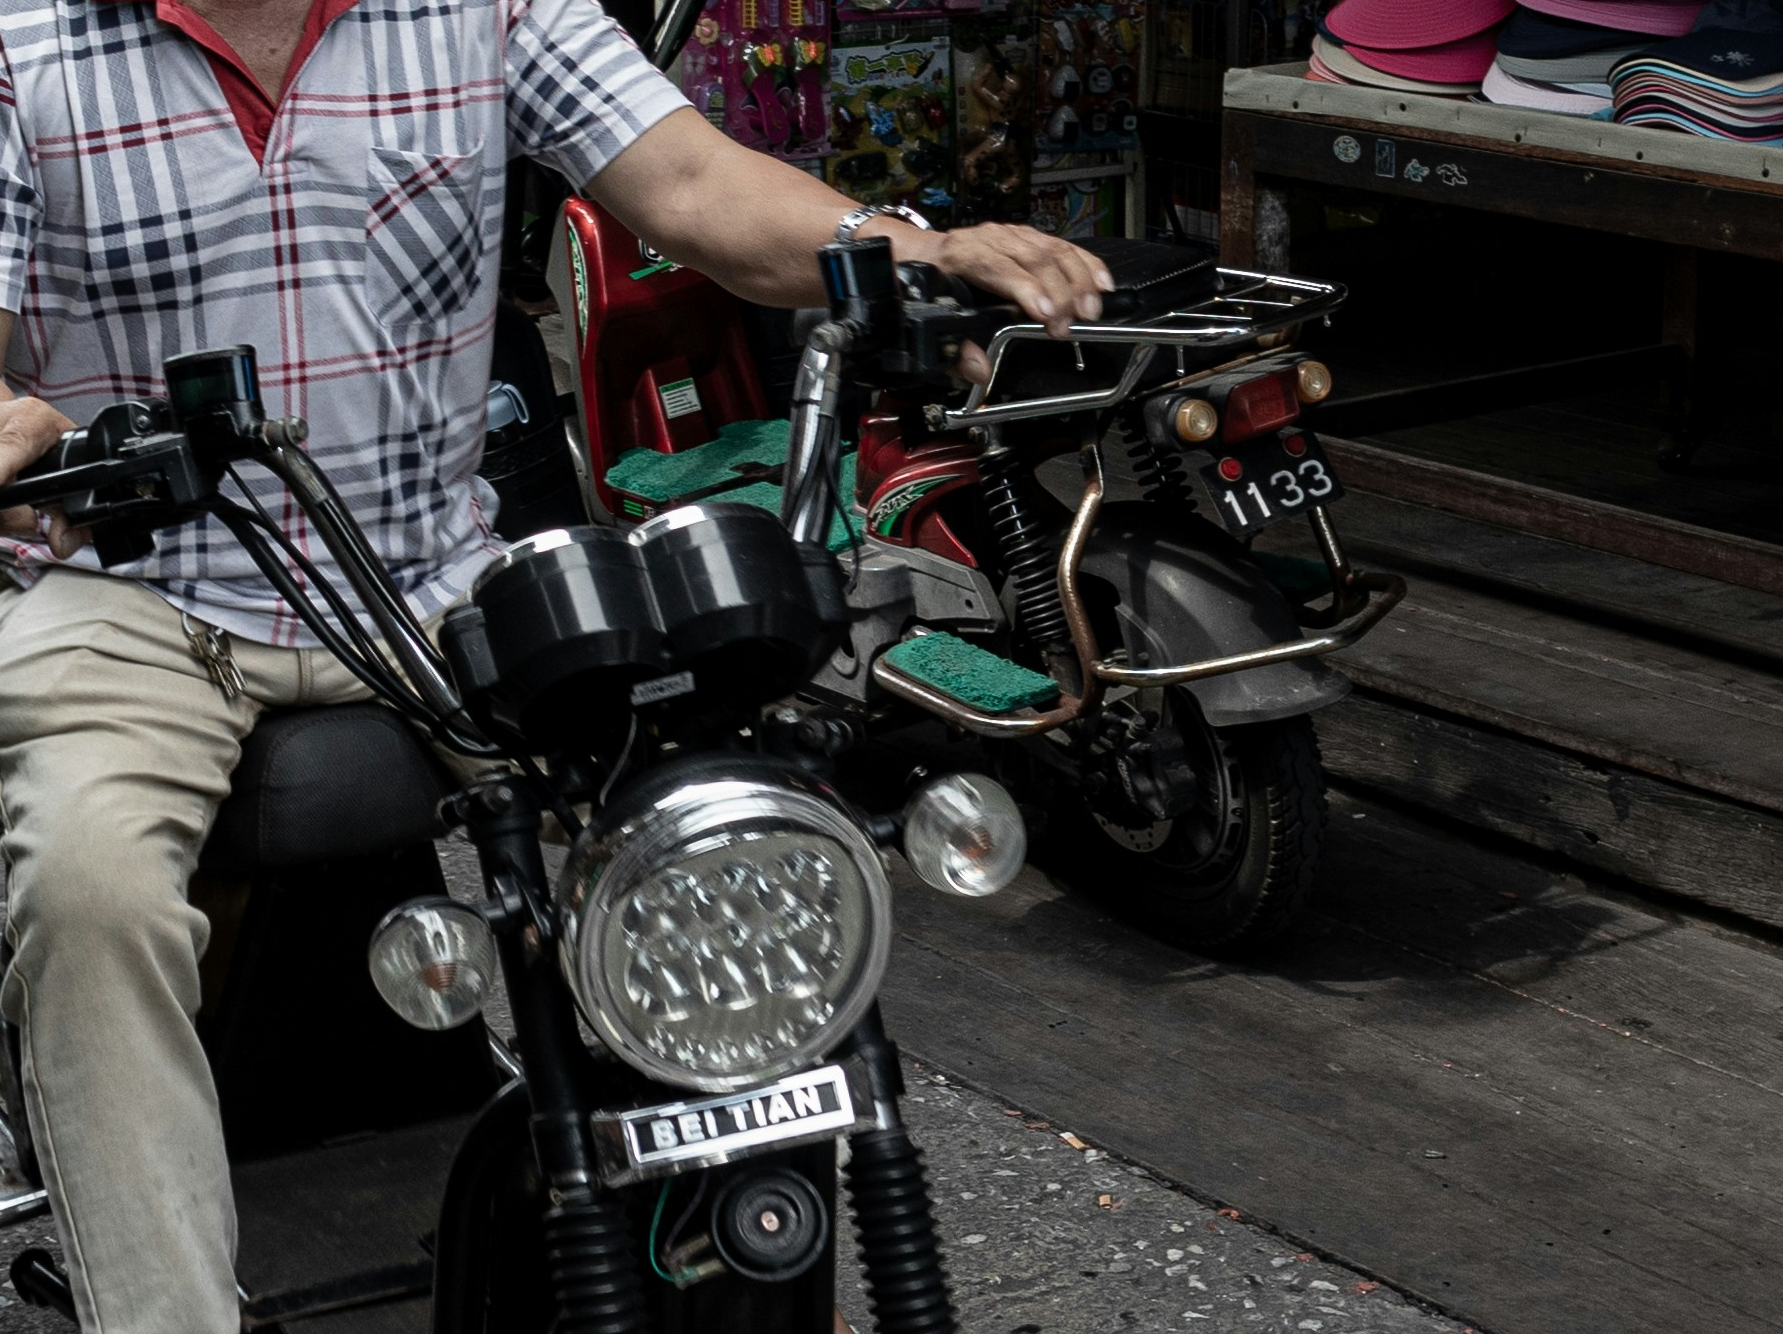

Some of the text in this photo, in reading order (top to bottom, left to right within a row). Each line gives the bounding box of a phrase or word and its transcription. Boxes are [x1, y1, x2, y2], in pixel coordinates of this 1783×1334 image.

[1223, 459, 1333, 527] 1133
[651, 1084, 823, 1151] BEI TIAN
